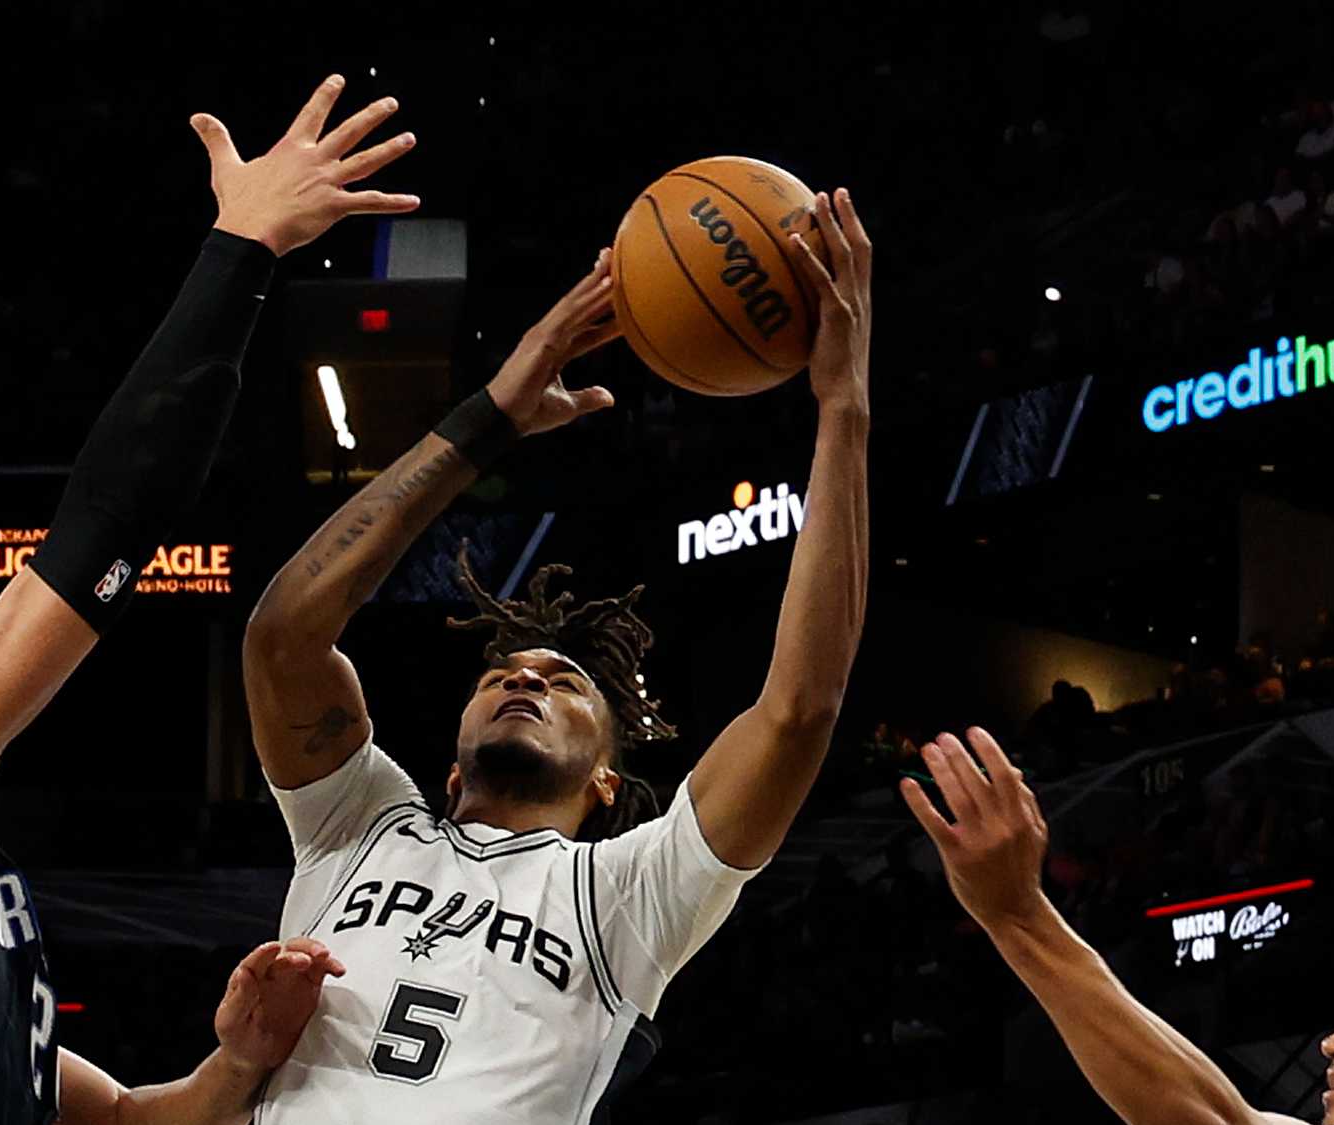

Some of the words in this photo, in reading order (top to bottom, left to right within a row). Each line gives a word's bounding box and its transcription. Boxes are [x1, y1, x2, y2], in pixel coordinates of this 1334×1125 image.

[677, 480, 806, 565] nextiv
[142, 545, 231, 576] AGLE
[334, 880, 572, 992] SPURS
[1173, 910, 1225, 941] WATCH
[1192, 937, 1215, 961] ON
[368, 979, 466, 1086] 5
